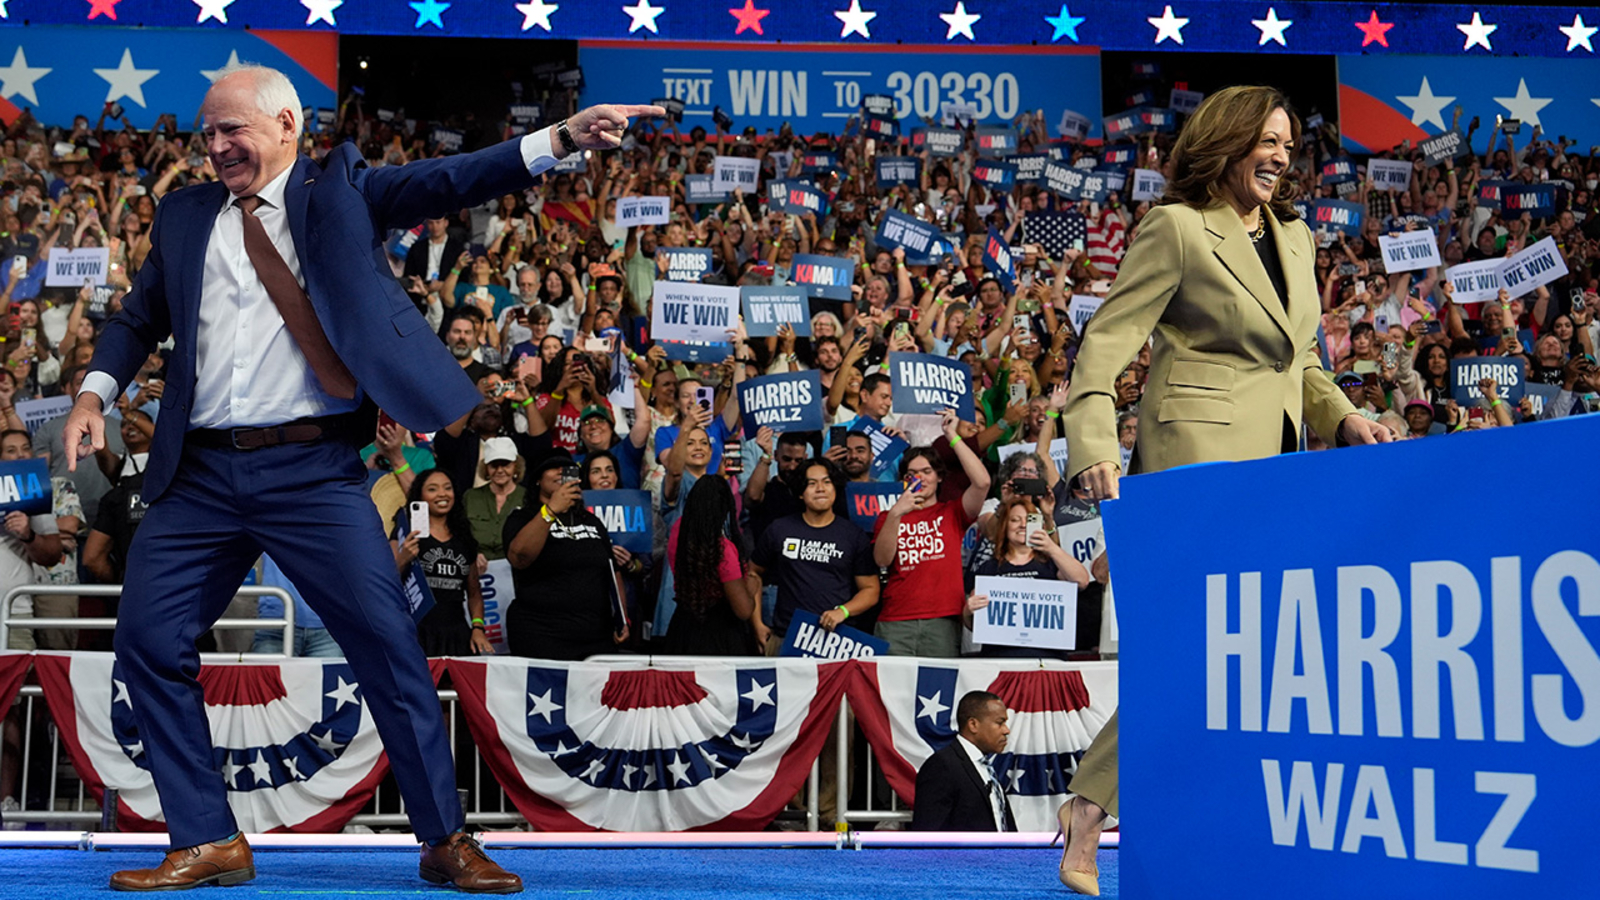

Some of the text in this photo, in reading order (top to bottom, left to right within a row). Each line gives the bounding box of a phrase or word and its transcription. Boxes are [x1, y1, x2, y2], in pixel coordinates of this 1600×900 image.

[662, 69, 1019, 119] TEXT WIN TO 30330
[927, 131, 961, 147] HARRIS
[980, 135, 1016, 148] KAMALA
[1422, 132, 1460, 156] HARRIS
[1432, 145, 1457, 161] WALZ
[721, 169, 756, 183] WE WIN
[880, 168, 916, 181] WE WIN
[974, 166, 1012, 184] KAMALA
[1044, 162, 1083, 188] HARRIS
[1084, 176, 1103, 191] RIS
[1372, 170, 1407, 183] WE WIN
[1048, 179, 1073, 194] WALZ
[1336, 182, 1357, 196] RRIS
[1505, 192, 1550, 209] KAMALA
[622, 205, 663, 219] WE WIN
[1316, 207, 1360, 227] KAMALA
[882, 221, 901, 242] WE
[903, 230, 930, 253] WIN
[1388, 243, 1433, 262] WE WIN
[56, 262, 101, 276] WE WIN
[668, 271, 701, 281] WALZ
[795, 263, 848, 287] KAMALA
[1503, 252, 1556, 288] WE WIN
[1454, 277, 1474, 293] WE
[665, 293, 691, 301] WHEN
[707, 296, 728, 304] VOTE
[749, 295, 800, 303] WHEN WE FIGHT
[663, 303, 729, 327] WE WIN
[750, 303, 803, 324] WE WIN
[900, 361, 966, 395] HARRIS
[1457, 364, 1518, 386] HARRIS
[743, 379, 812, 414] HARRIS
[914, 389, 960, 409] WALZ
[1468, 387, 1509, 399] WZ
[25, 409, 46, 417] WHEN
[60, 405, 74, 413] VO
[754, 407, 802, 426] WALZ
[0, 472, 44, 503] ALA
[854, 494, 901, 516] KAM
[587, 505, 646, 533] MALA
[800, 546, 844, 559] EQUALITY
[806, 540, 821, 548] AM
[822, 542, 836, 550] AN
[421, 547, 470, 576] HOWARD
[800, 553, 829, 563] VOTER
[437, 563, 457, 575] HU
[989, 589, 1063, 602] WHEN WE VOTE
[987, 601, 1065, 630] WE WIN
[793, 622, 875, 659] HARRIS
[1206, 550, 1600, 748] HARRIS
[1261, 758, 1539, 873] WALZ
